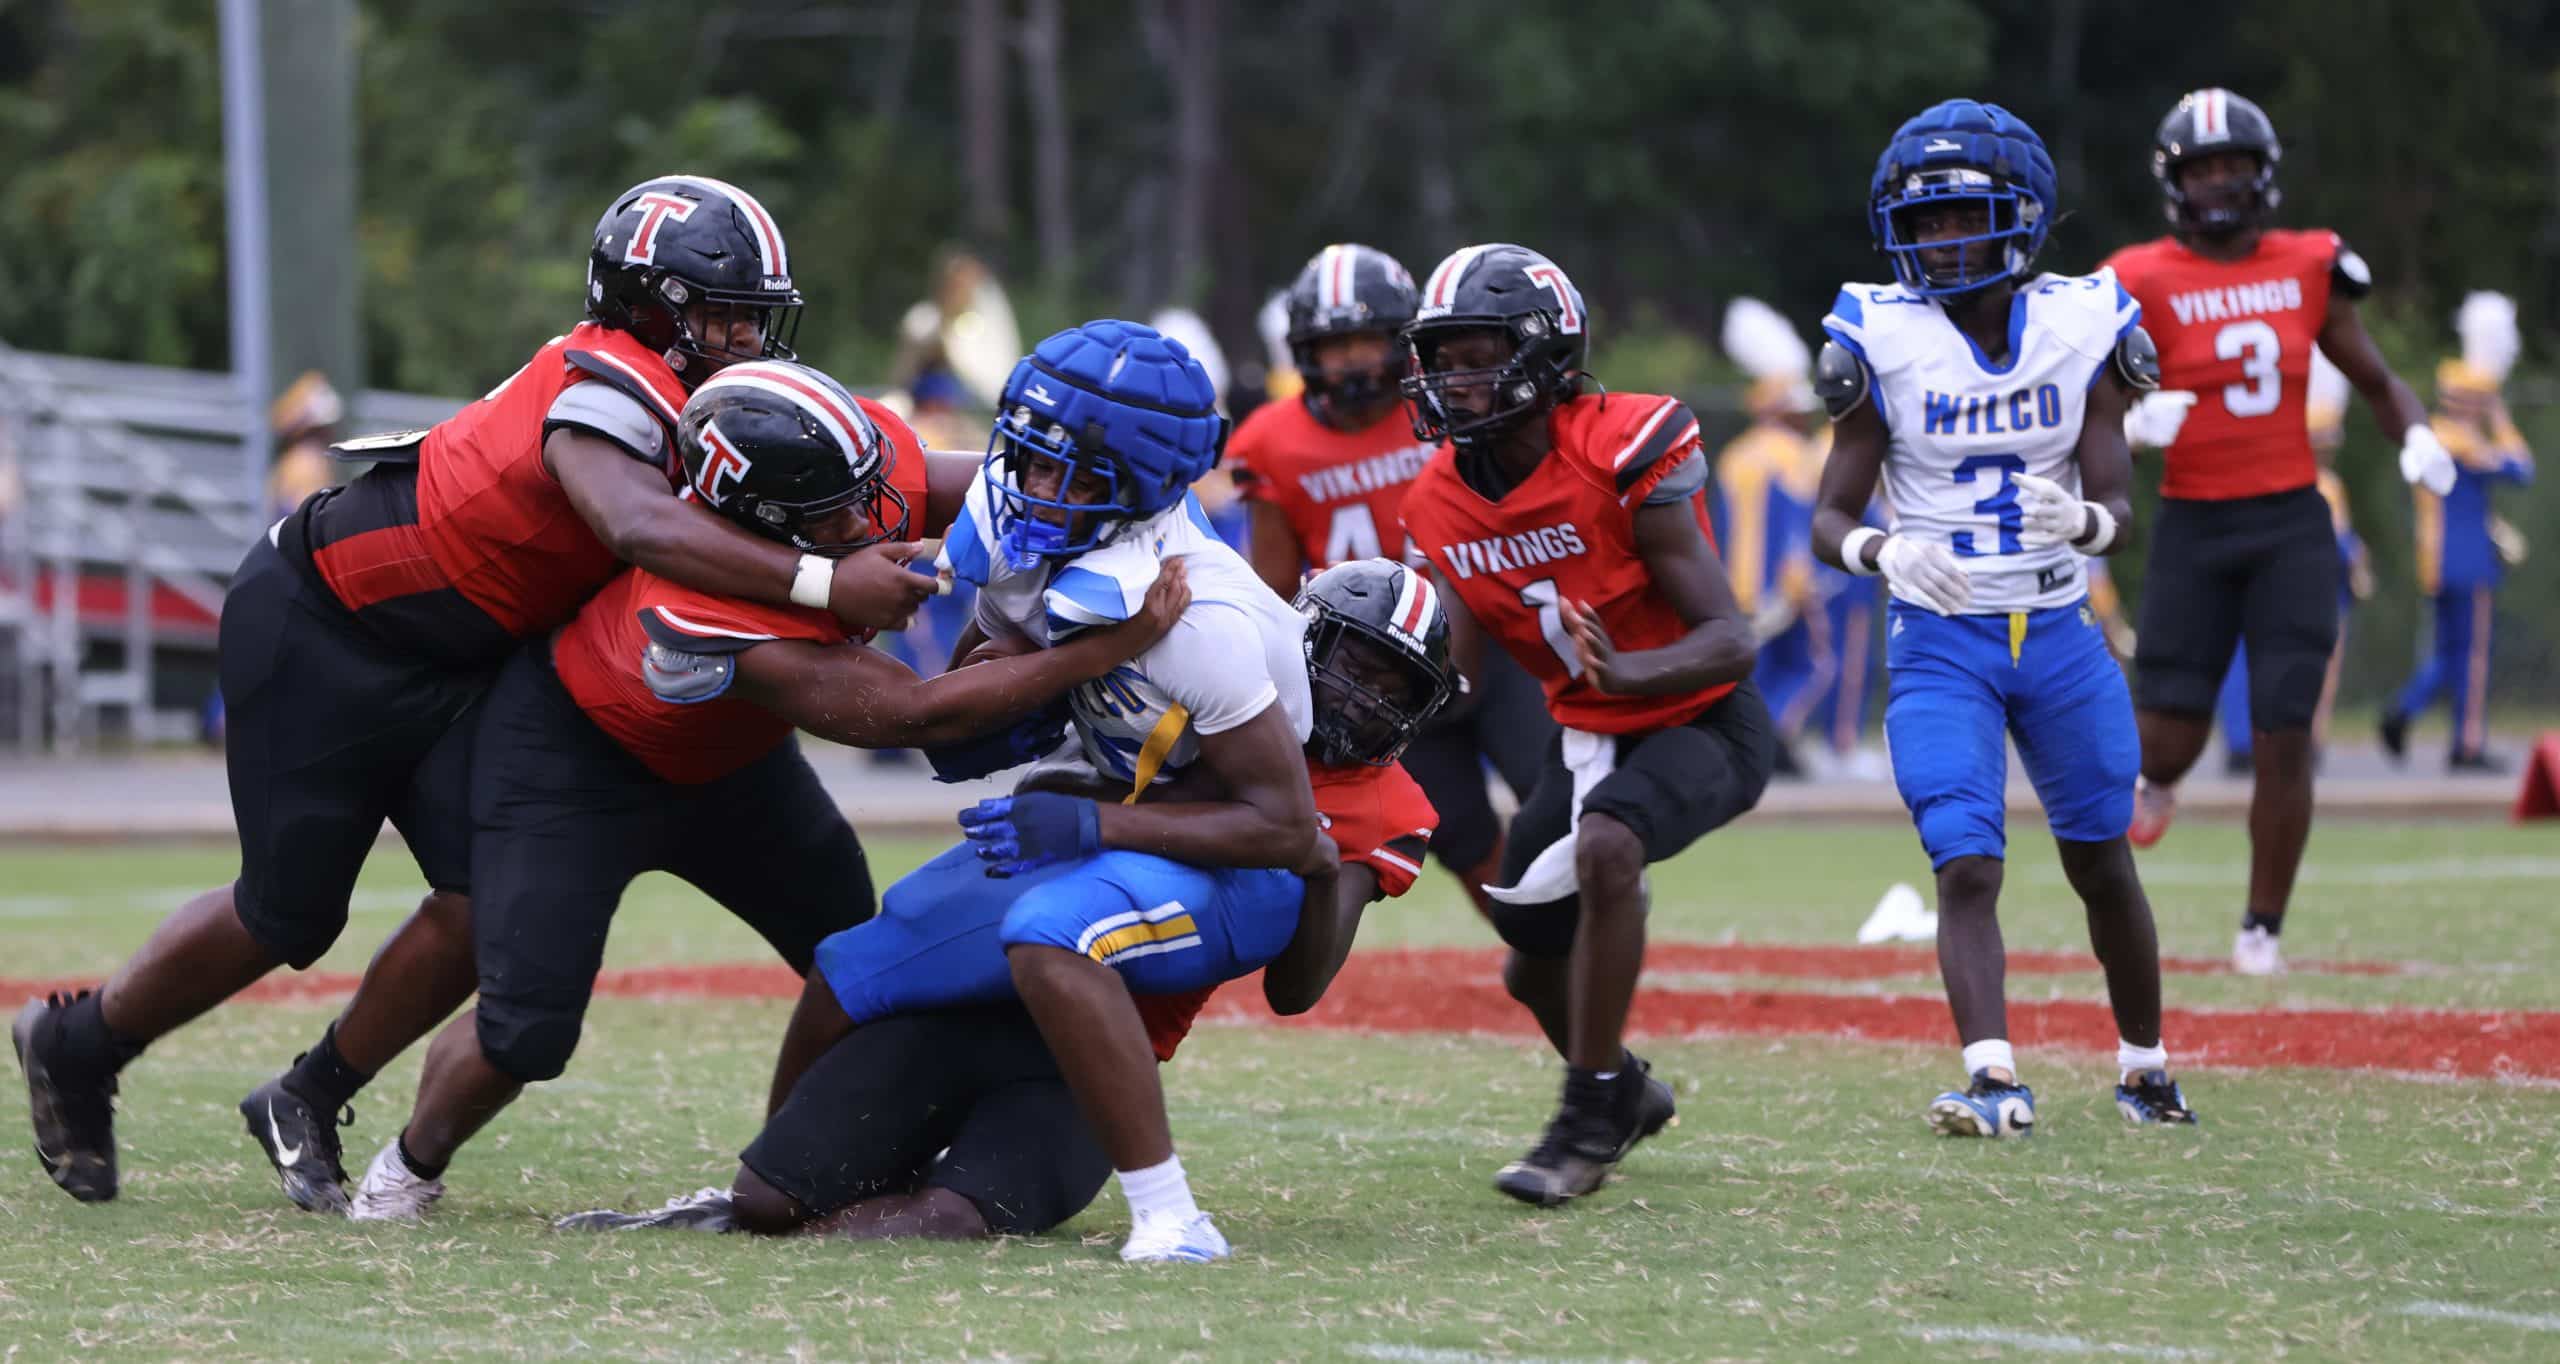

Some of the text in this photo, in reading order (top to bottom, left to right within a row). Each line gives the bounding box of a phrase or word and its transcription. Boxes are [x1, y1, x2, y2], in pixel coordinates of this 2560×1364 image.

[624, 191, 699, 266] T
[1521, 264, 1581, 335] T
[2168, 277, 2303, 327] VIKINGS
[2214, 319, 2282, 418] 3
[1924, 383, 2062, 435] WILCO
[696, 418, 753, 508] T
[1950, 453, 2027, 558] 3
[1440, 521, 1587, 580] VIKINGS
[1386, 624, 1427, 655] Riddell
